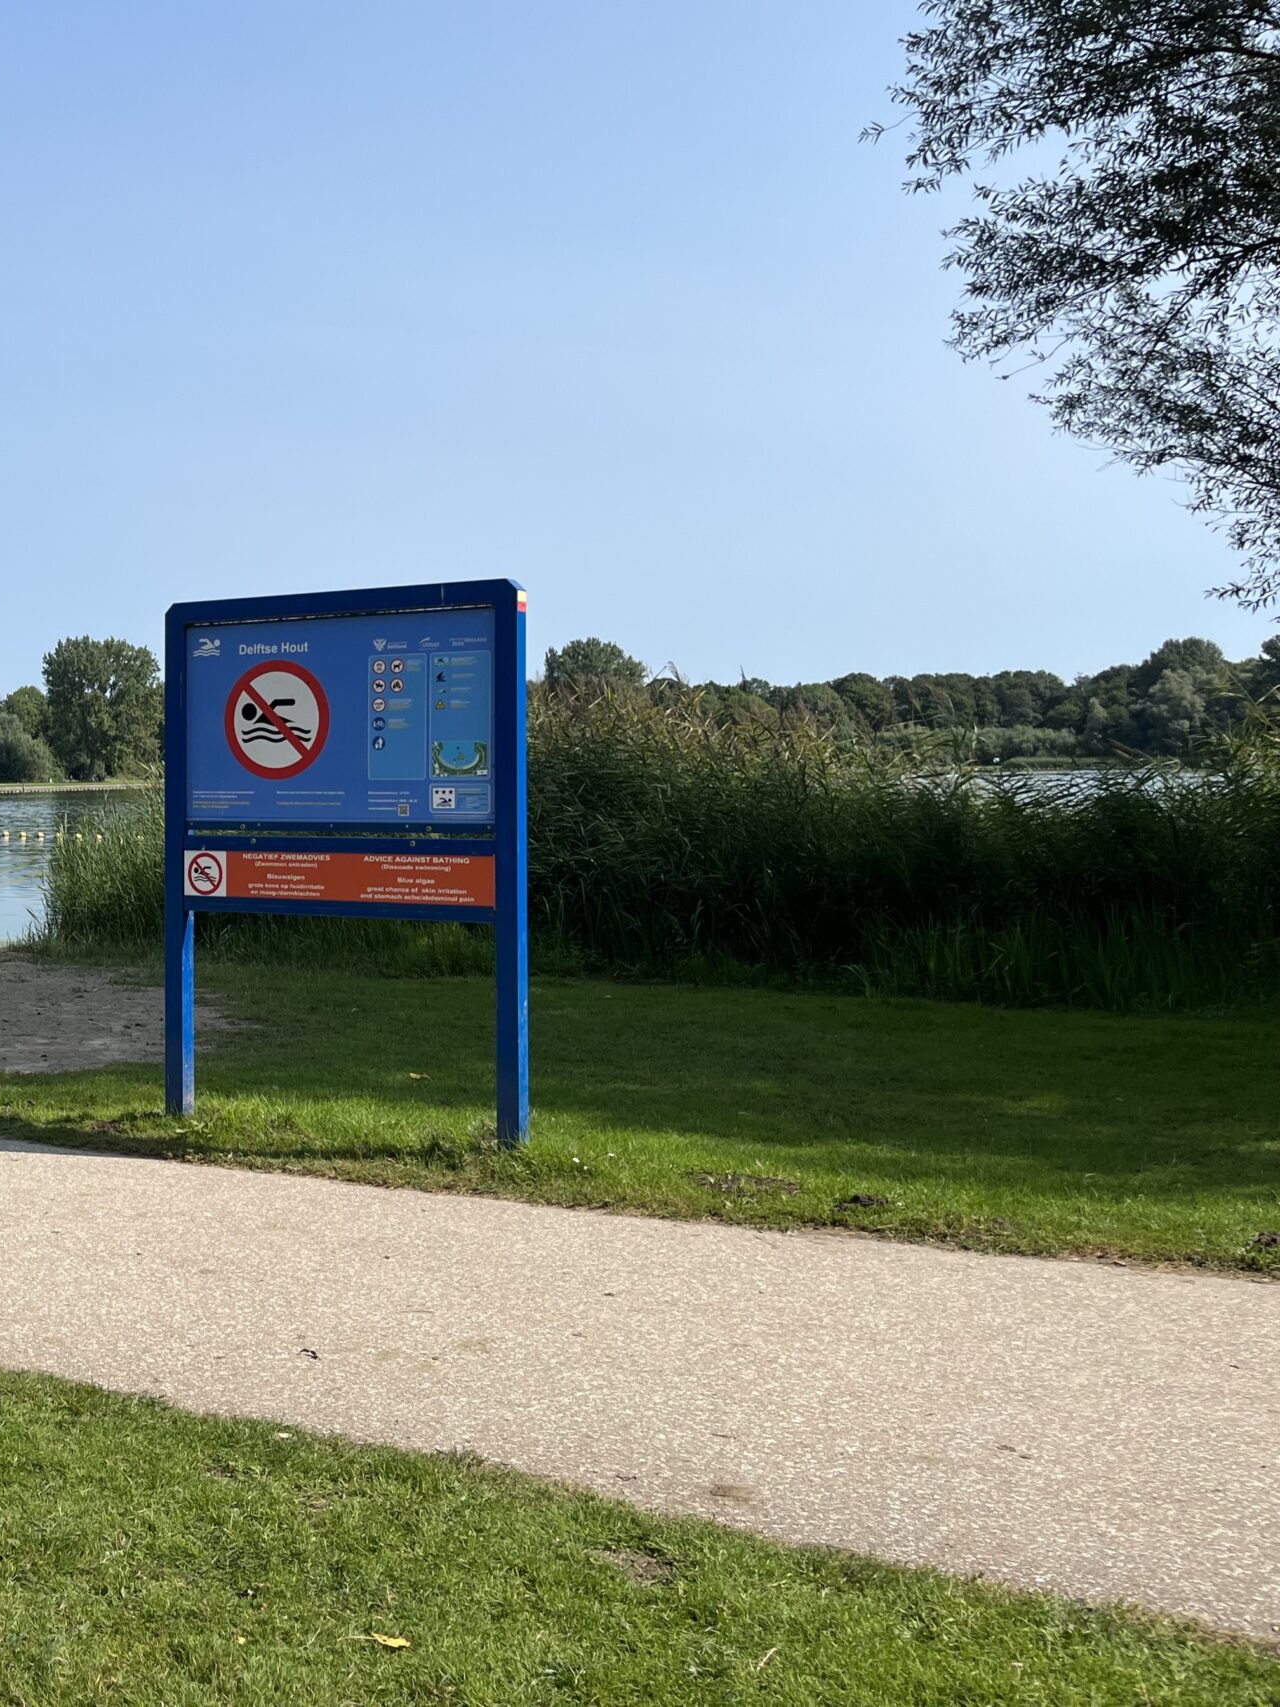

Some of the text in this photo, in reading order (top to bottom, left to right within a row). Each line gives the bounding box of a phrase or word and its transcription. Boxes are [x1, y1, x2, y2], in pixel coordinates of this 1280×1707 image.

[239, 641, 309, 655] Delftse Hout
[266, 873, 305, 881] Blauwalgen
